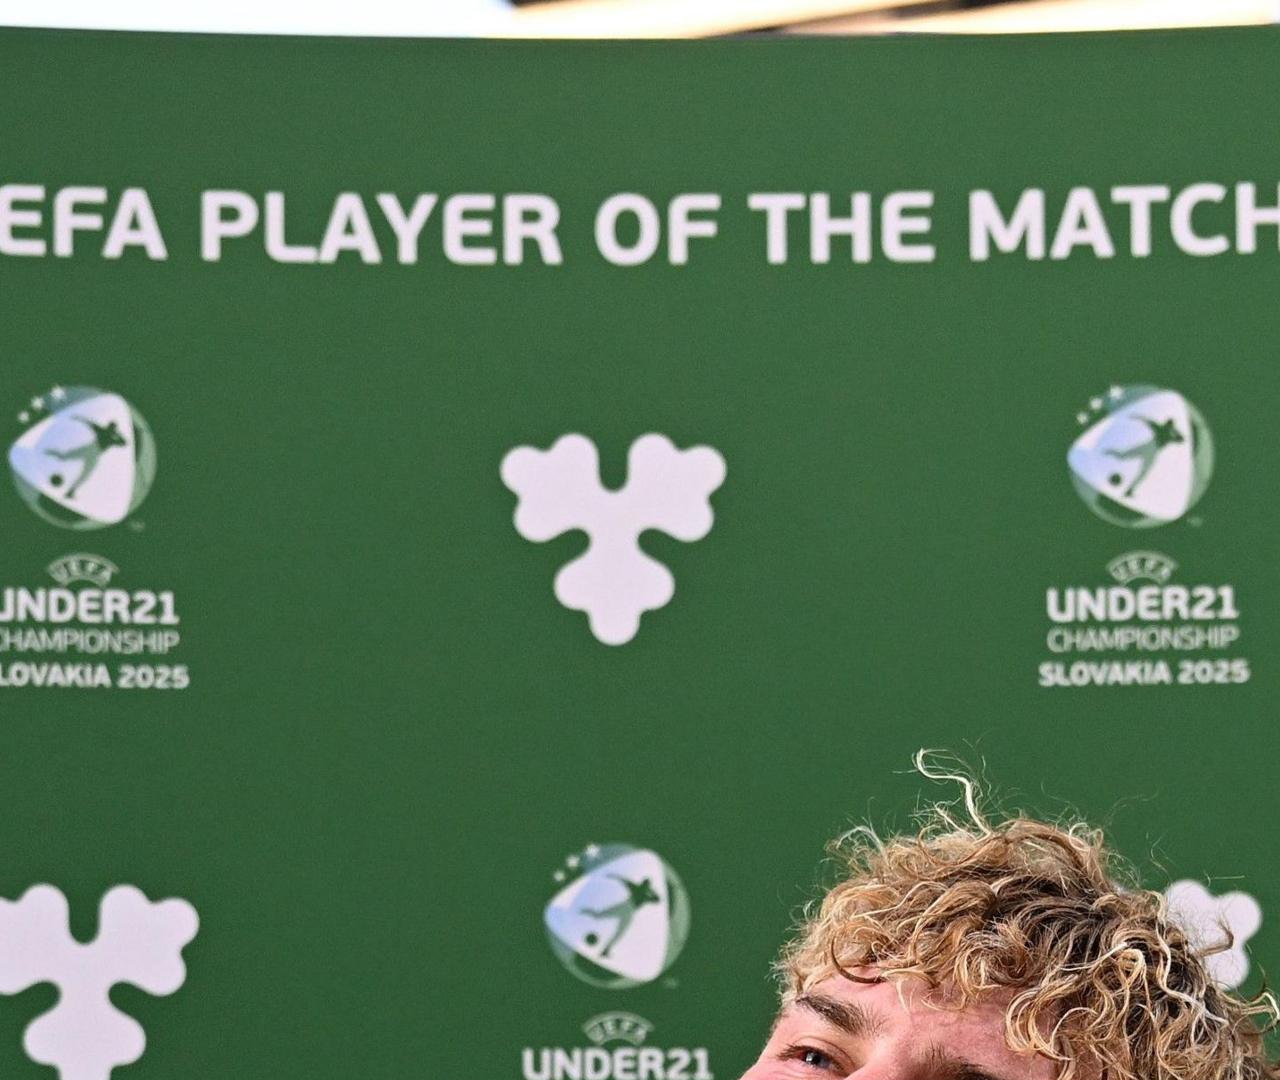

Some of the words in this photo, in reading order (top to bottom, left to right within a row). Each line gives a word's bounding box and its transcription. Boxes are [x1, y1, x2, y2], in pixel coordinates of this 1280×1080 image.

[202, 190, 562, 265] PLAYER
[595, 193, 721, 265] OF
[748, 191, 935, 264] THE
[1046, 585, 1240, 622] UNDER21
[1047, 625, 1240, 652] CHAMPIONSHIP
[118, 665, 190, 689] 2025
[1039, 661, 1170, 686] SLOVAKIA
[1178, 659, 1250, 683] 2025
